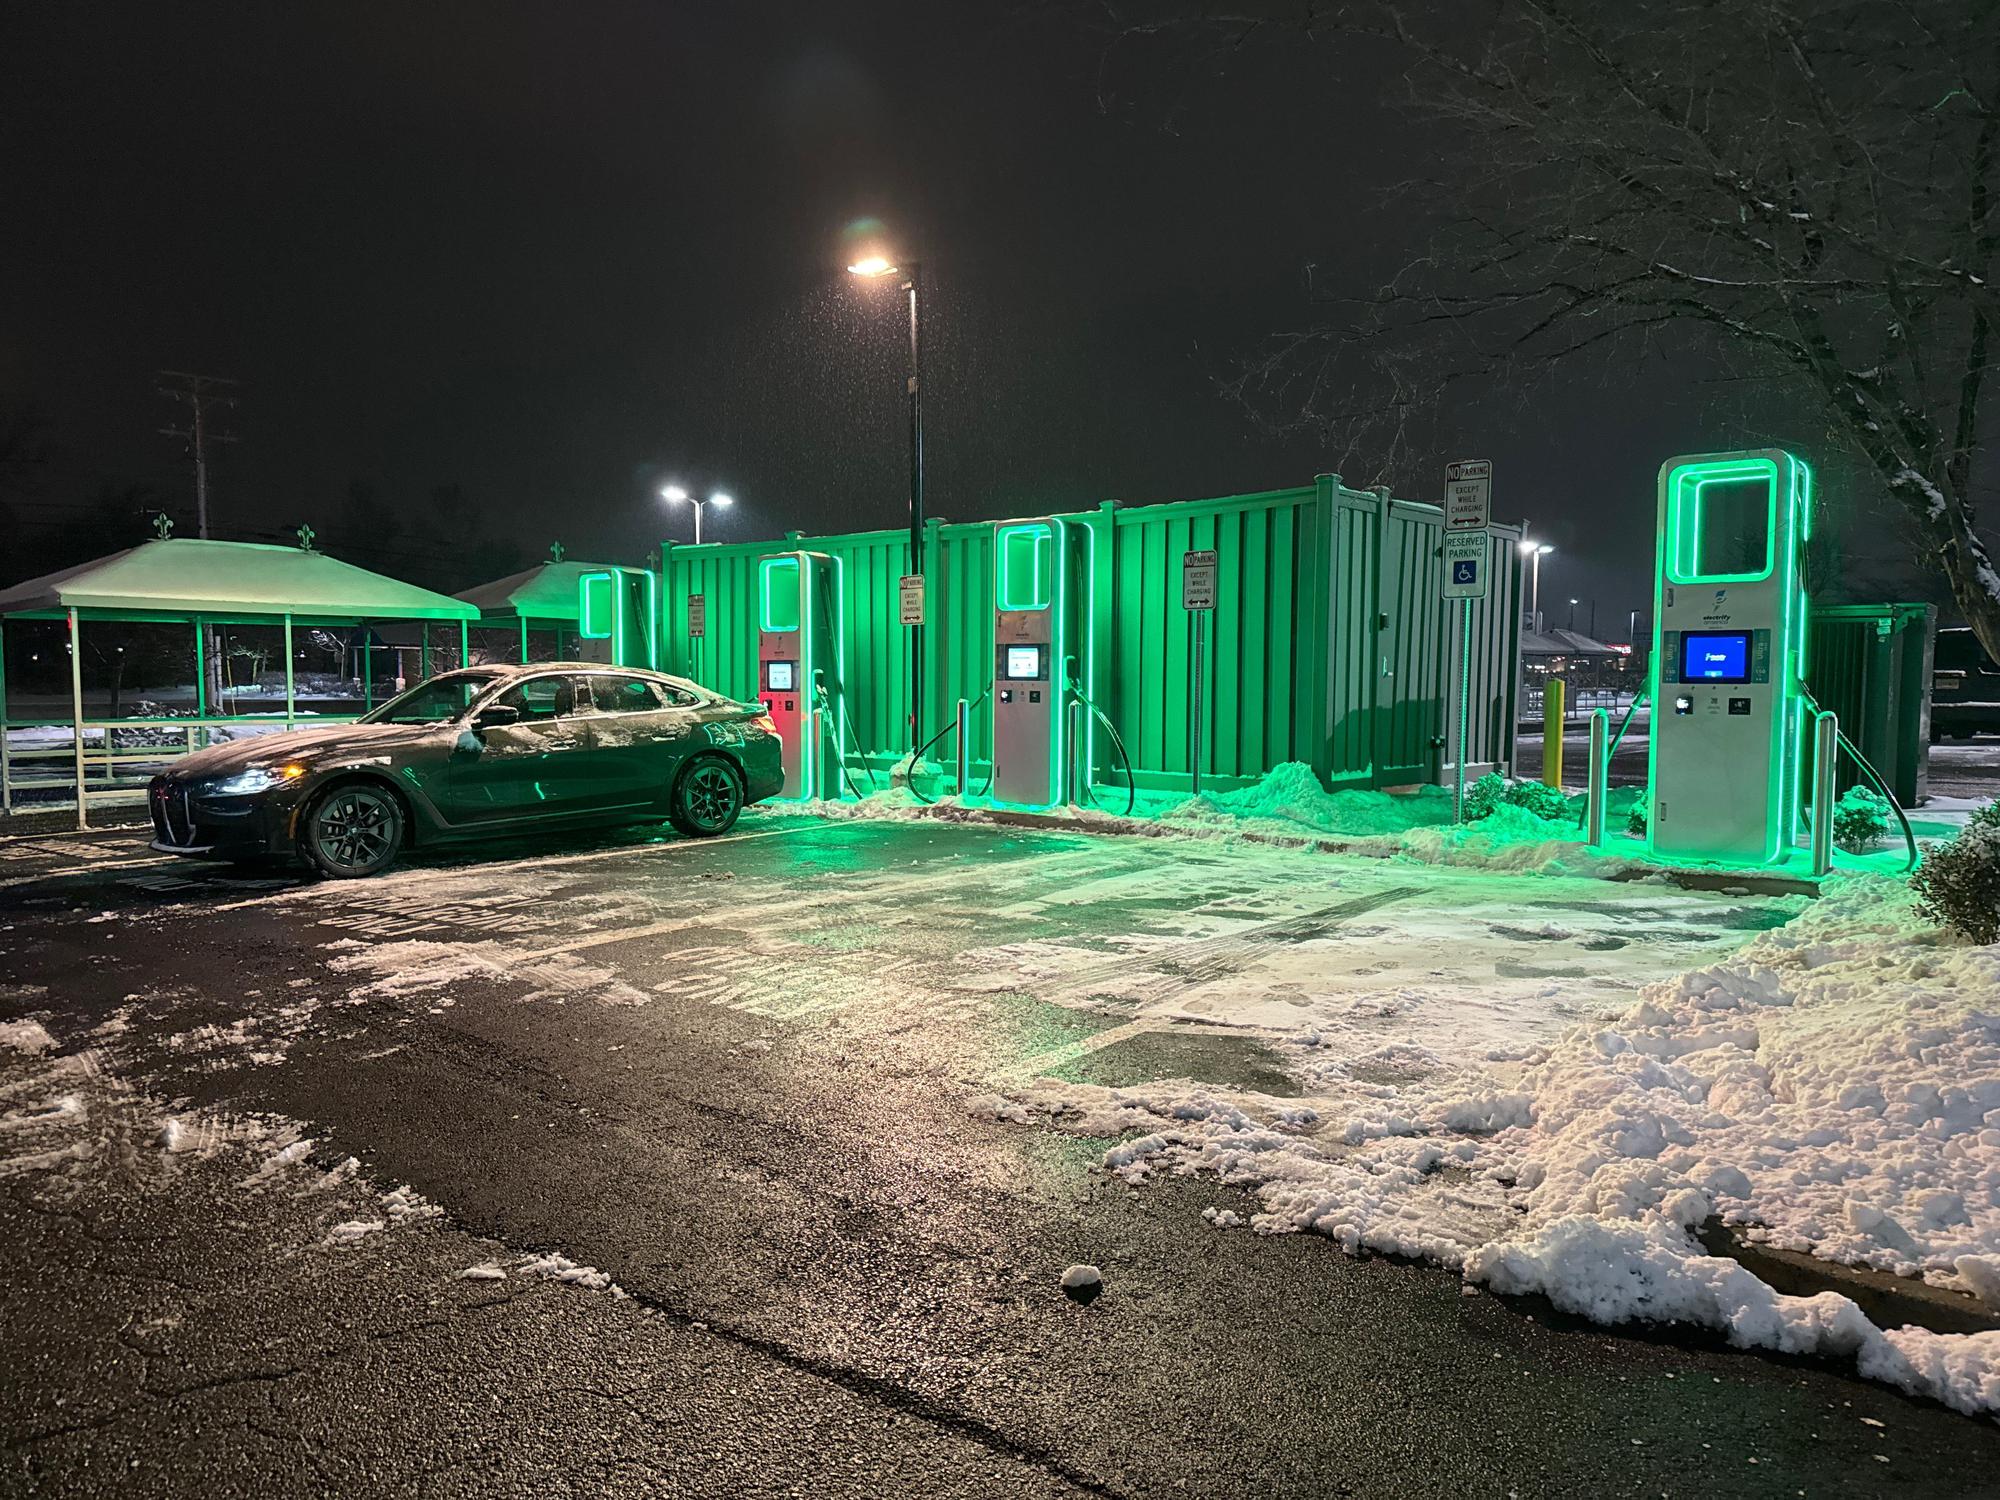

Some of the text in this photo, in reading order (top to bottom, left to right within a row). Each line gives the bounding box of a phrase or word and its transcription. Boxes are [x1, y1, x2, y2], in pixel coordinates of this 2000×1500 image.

[1447, 466, 1488, 480] NO PARKING
[1456, 485, 1480, 494] EXCEPT
[1458, 495, 1477, 503] WHILE
[1451, 504, 1483, 513] CHARGING
[1447, 536, 1486, 547] RESERVED
[1449, 548, 1482, 558] PARKING
[1184, 553, 1194, 567] NO
